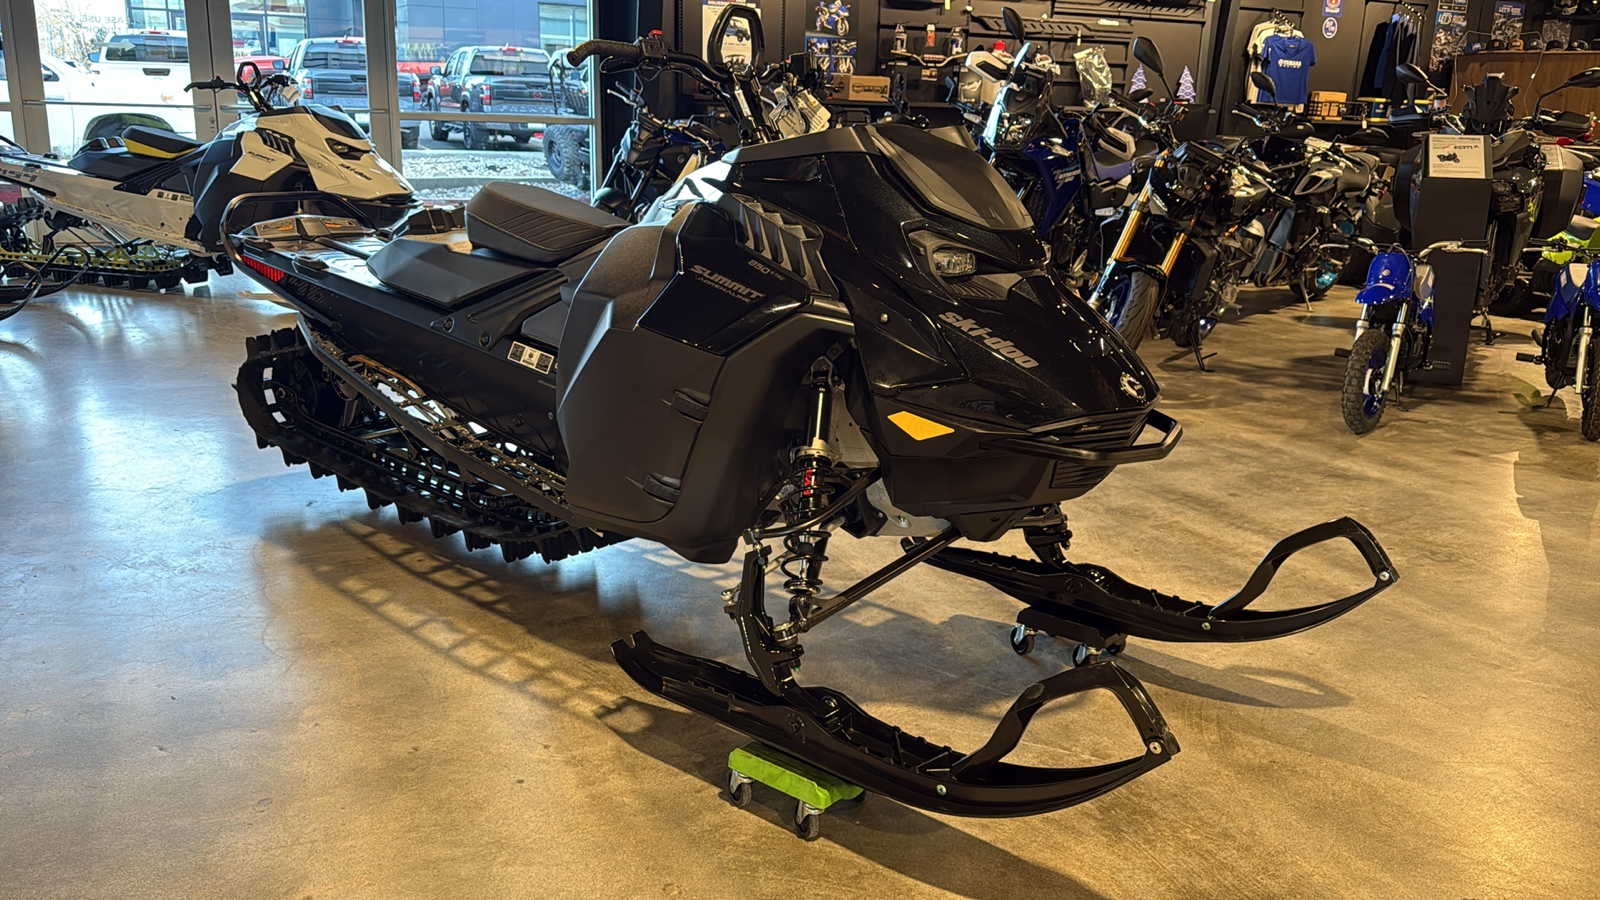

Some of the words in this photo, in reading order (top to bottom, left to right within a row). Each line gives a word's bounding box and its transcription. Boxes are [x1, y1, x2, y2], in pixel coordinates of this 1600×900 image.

[748, 260, 771, 274] 850
[690, 264, 764, 299] SUMMIT
[697, 277, 752, 304] ADRENALINE
